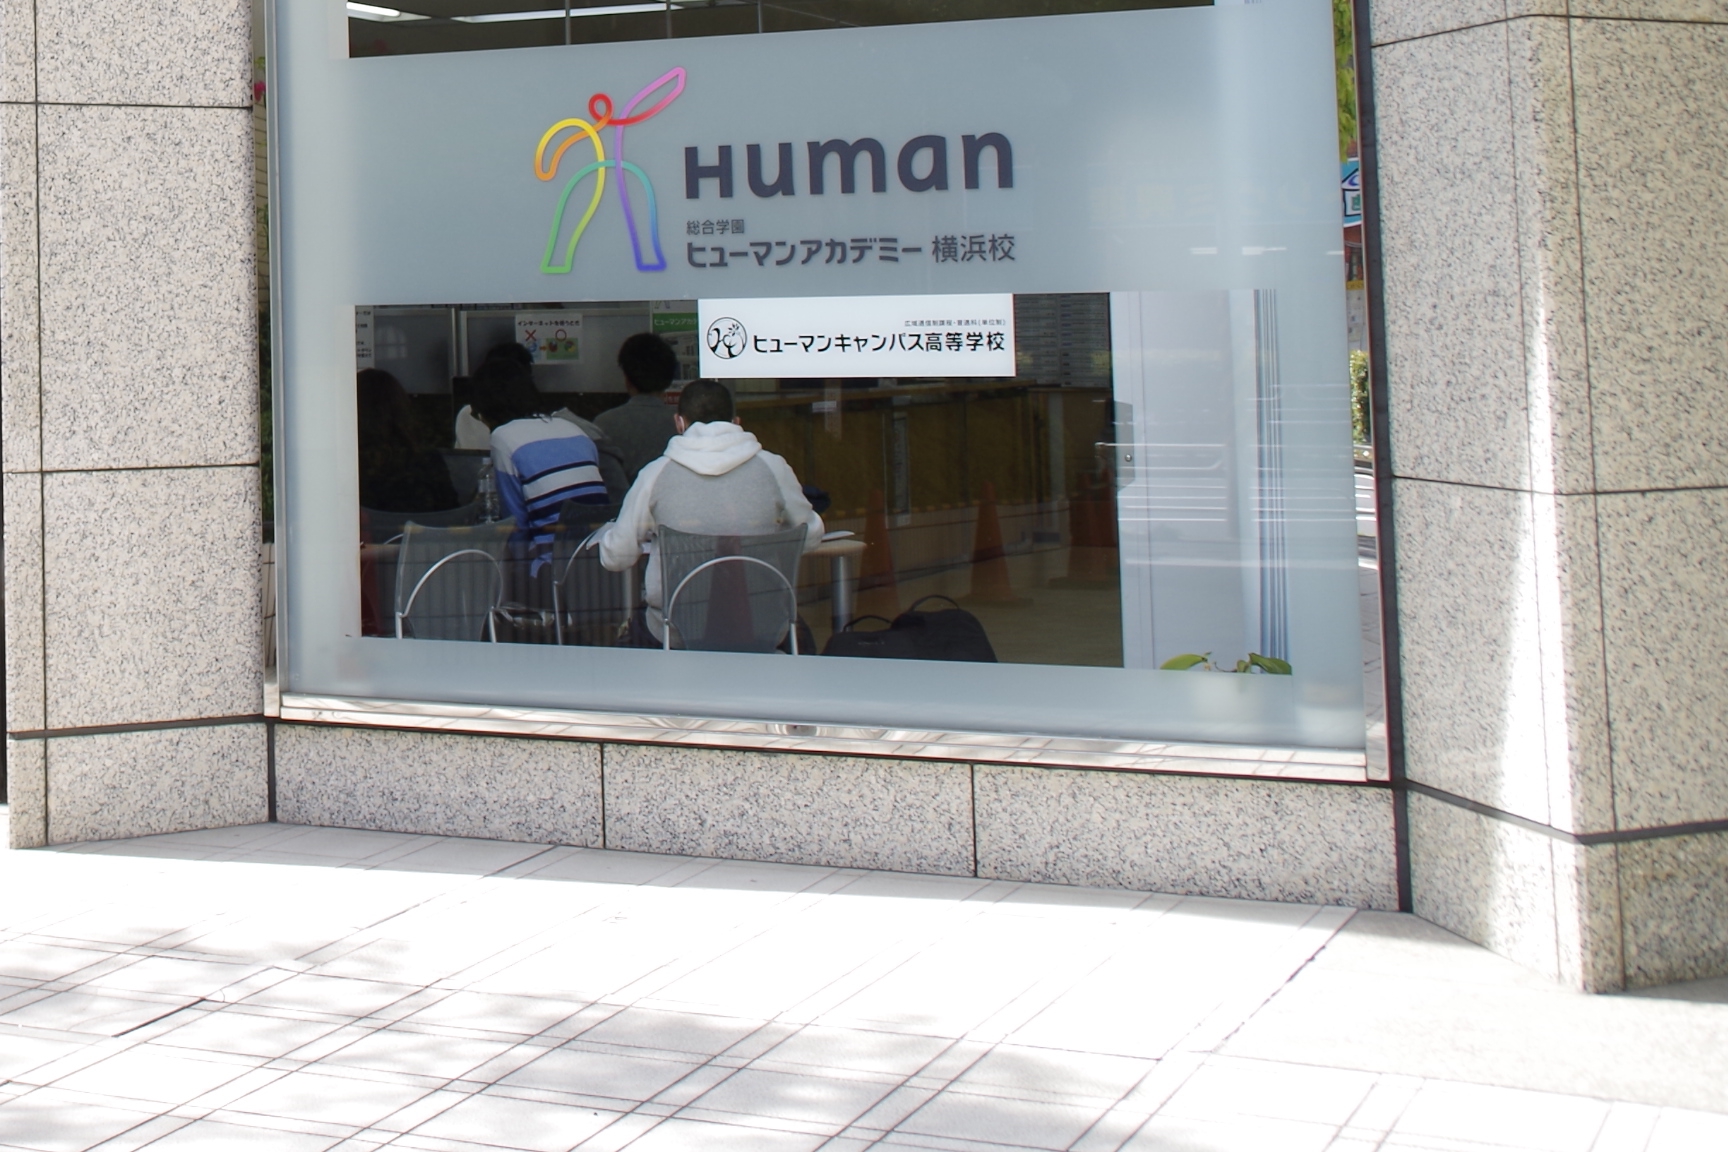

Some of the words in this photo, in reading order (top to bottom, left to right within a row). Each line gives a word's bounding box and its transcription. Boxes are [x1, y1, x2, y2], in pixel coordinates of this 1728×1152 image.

[684, 131, 1014, 200] Human
[686, 219, 745, 236] 総合学園
[686, 236, 923, 268] ヒューマンアカデミー
[931, 234, 1016, 264] 横浜校
[753, 331, 1005, 354] ヒューマンキャンパス高等学校
